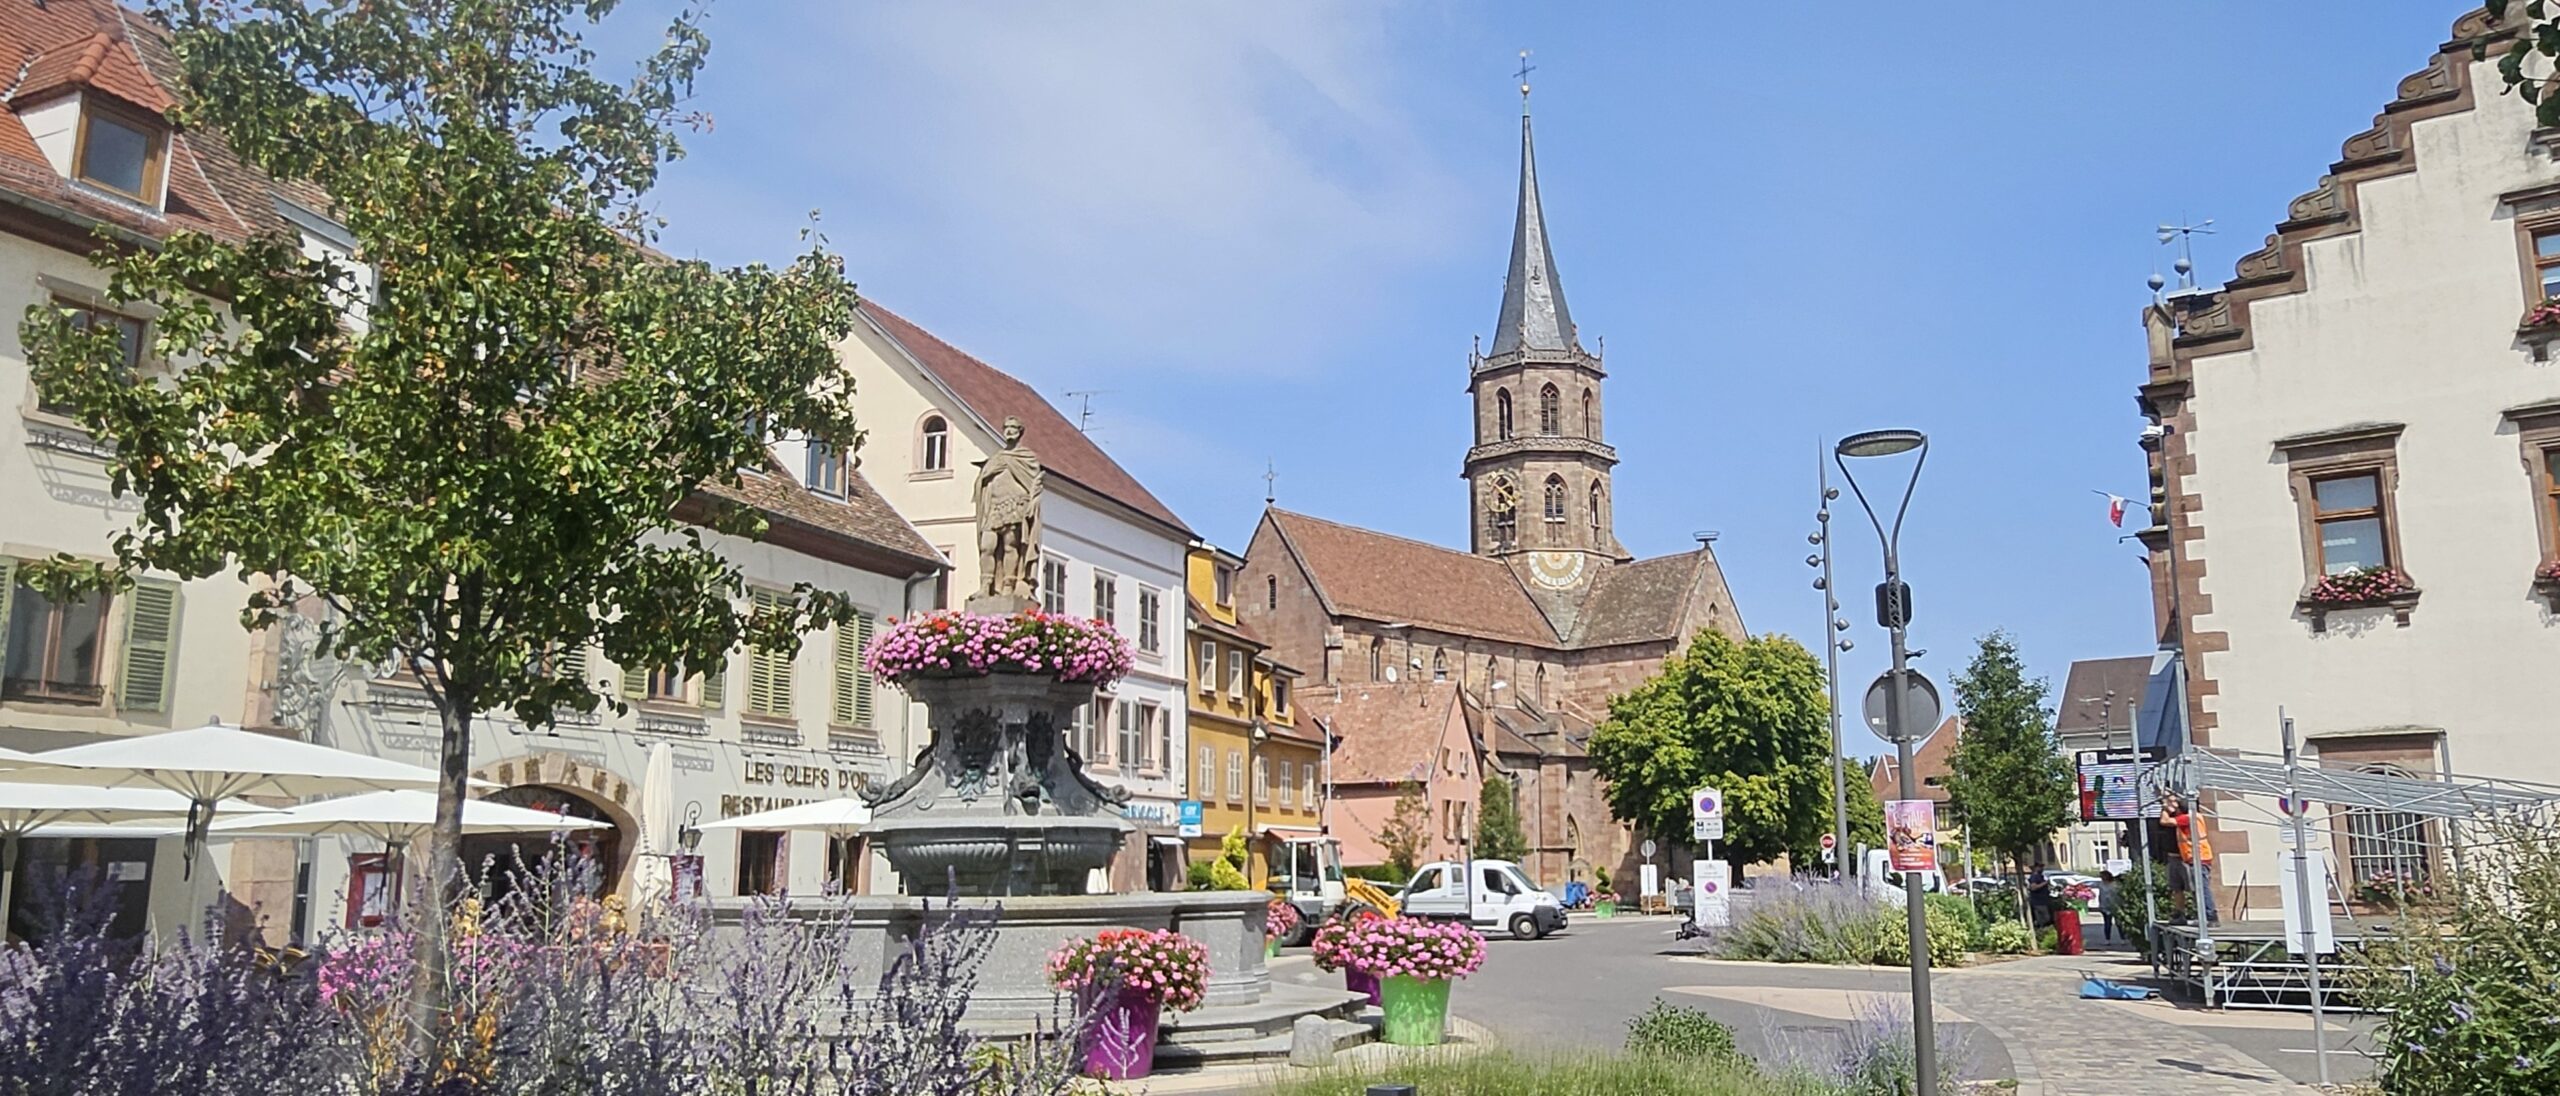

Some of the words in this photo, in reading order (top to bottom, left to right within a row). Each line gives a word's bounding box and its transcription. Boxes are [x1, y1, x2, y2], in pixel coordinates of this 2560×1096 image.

[744, 760, 774, 784] LES
[784, 764, 830, 789] CLEFS
[838, 769, 869, 791] D'OR
